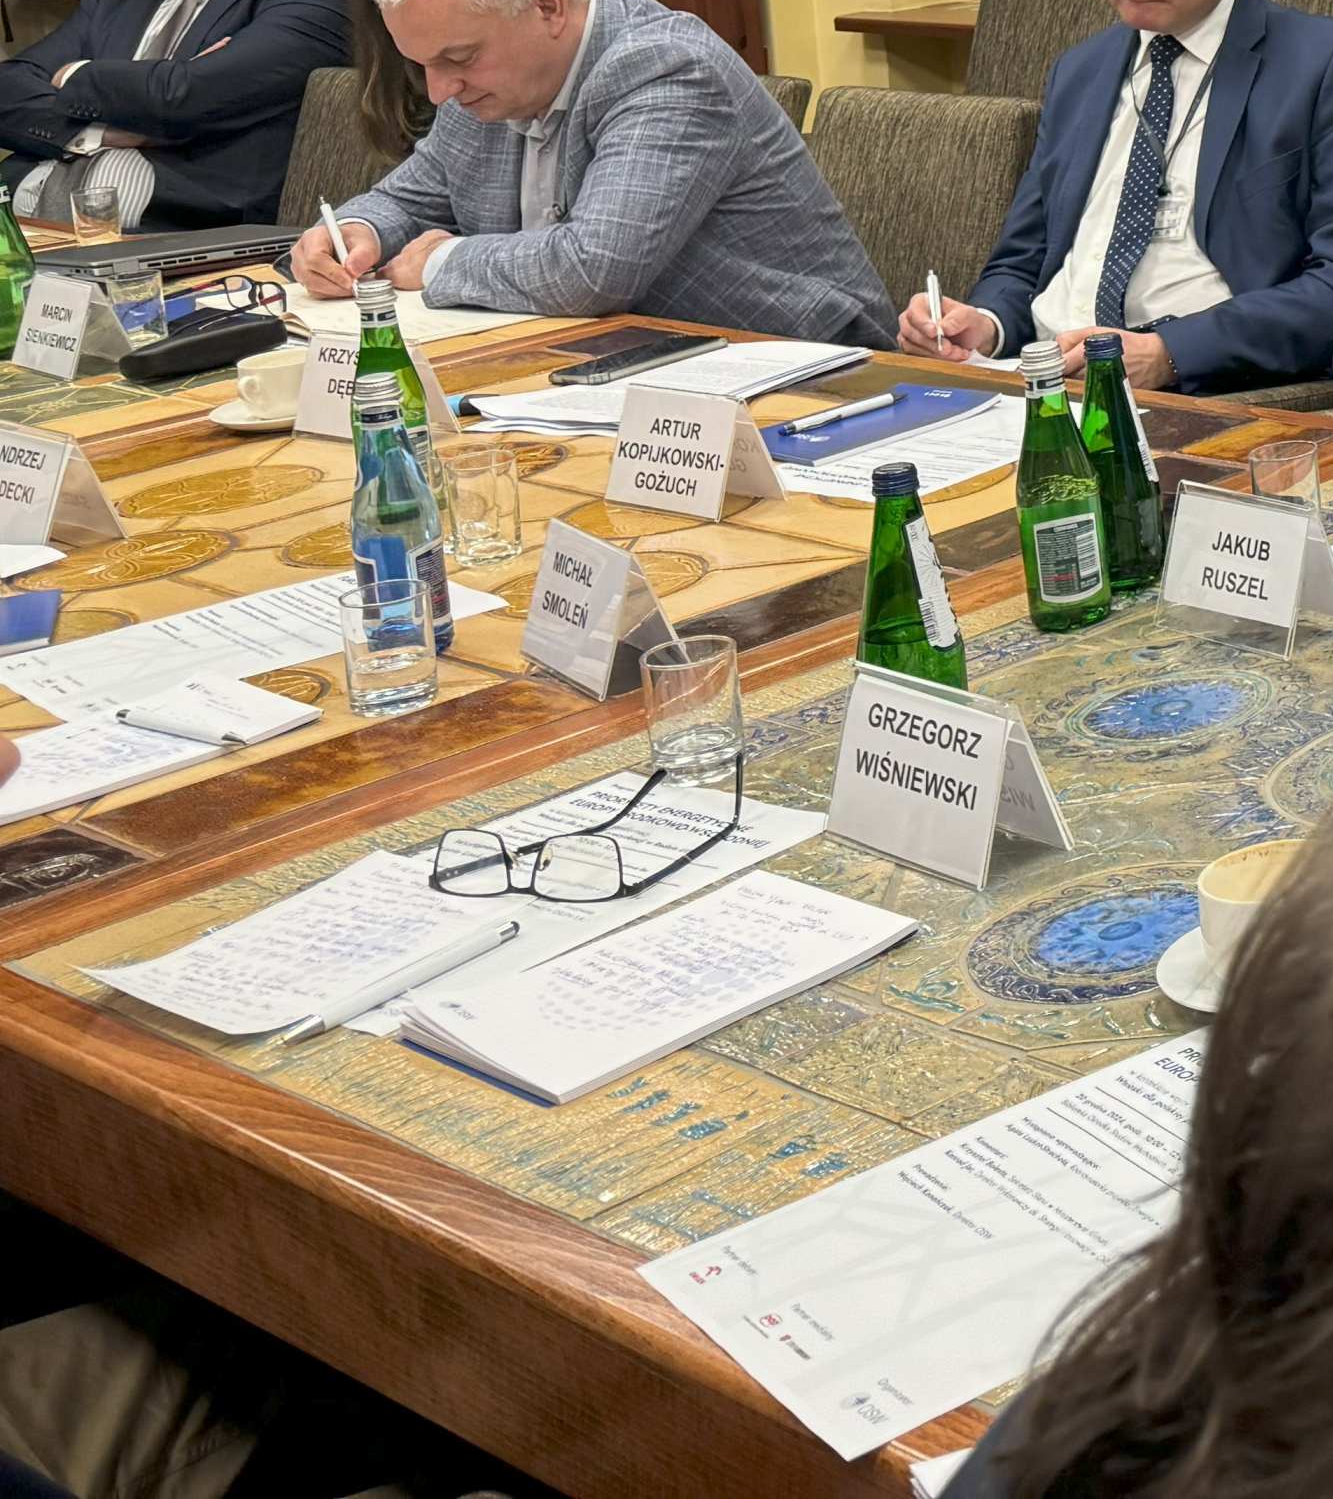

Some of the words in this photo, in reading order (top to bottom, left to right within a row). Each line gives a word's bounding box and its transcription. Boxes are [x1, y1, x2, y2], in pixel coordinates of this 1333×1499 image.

[41, 303, 73, 324] MARCIN
[25, 327, 77, 352] SIENKIEWICZ
[318, 347, 360, 366] KRZYS
[327, 378, 356, 399] DĘB
[650, 417, 702, 441] ARTUR
[0, 444, 46, 471] NDRZEJ
[617, 441, 725, 474] KOPIJKOWSKI-
[0, 480, 35, 504] DECKI
[634, 467, 698, 498] GOŻUCH
[1211, 531, 1271, 562] JAKUB
[552, 551, 595, 588] MICHAŁ
[1201, 566, 1269, 601] RUSZEL
[541, 589, 592, 630] SMOLEŃ
[868, 702, 983, 759] GRZEGORZ
[855, 748, 979, 811] WIŚNIEWSKI
